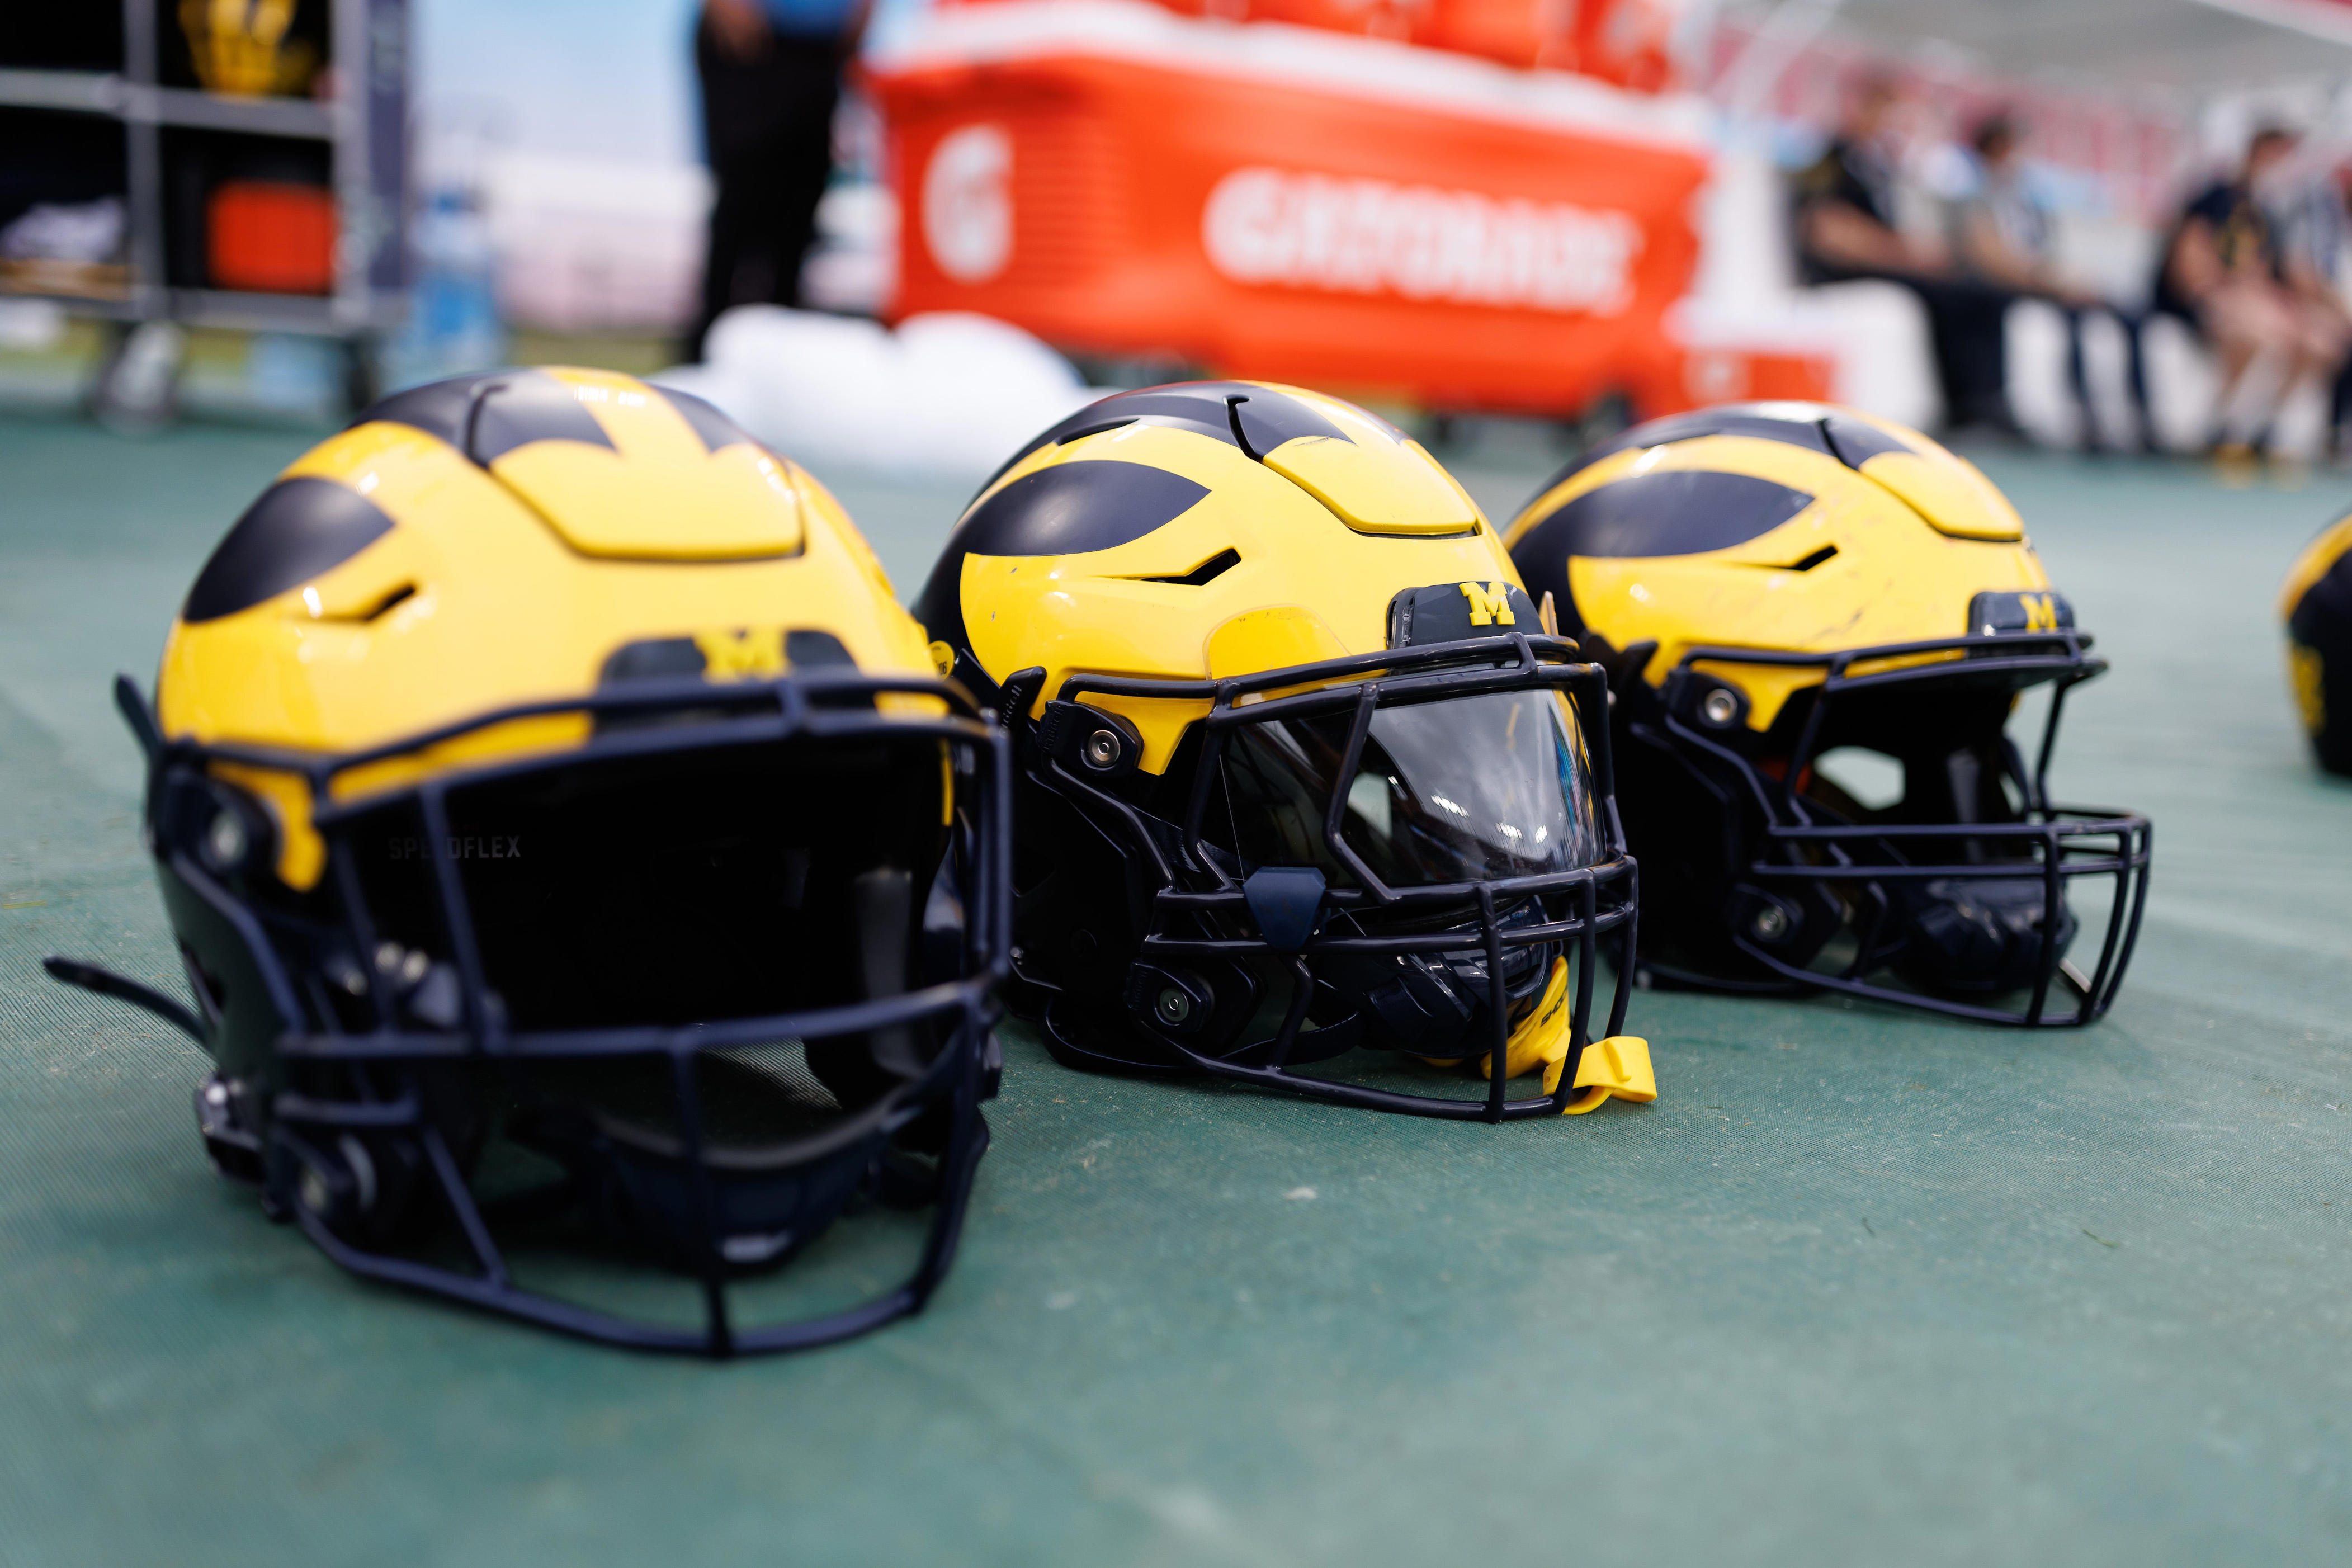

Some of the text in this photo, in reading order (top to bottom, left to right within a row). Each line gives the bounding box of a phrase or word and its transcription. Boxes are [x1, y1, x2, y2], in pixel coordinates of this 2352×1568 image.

[1202, 168, 1643, 317] GATORADE
[1459, 582, 1515, 626] M
[2019, 593, 2058, 634] M
[694, 629, 788, 685] M
[388, 835, 521, 859] SPEDFLEX
